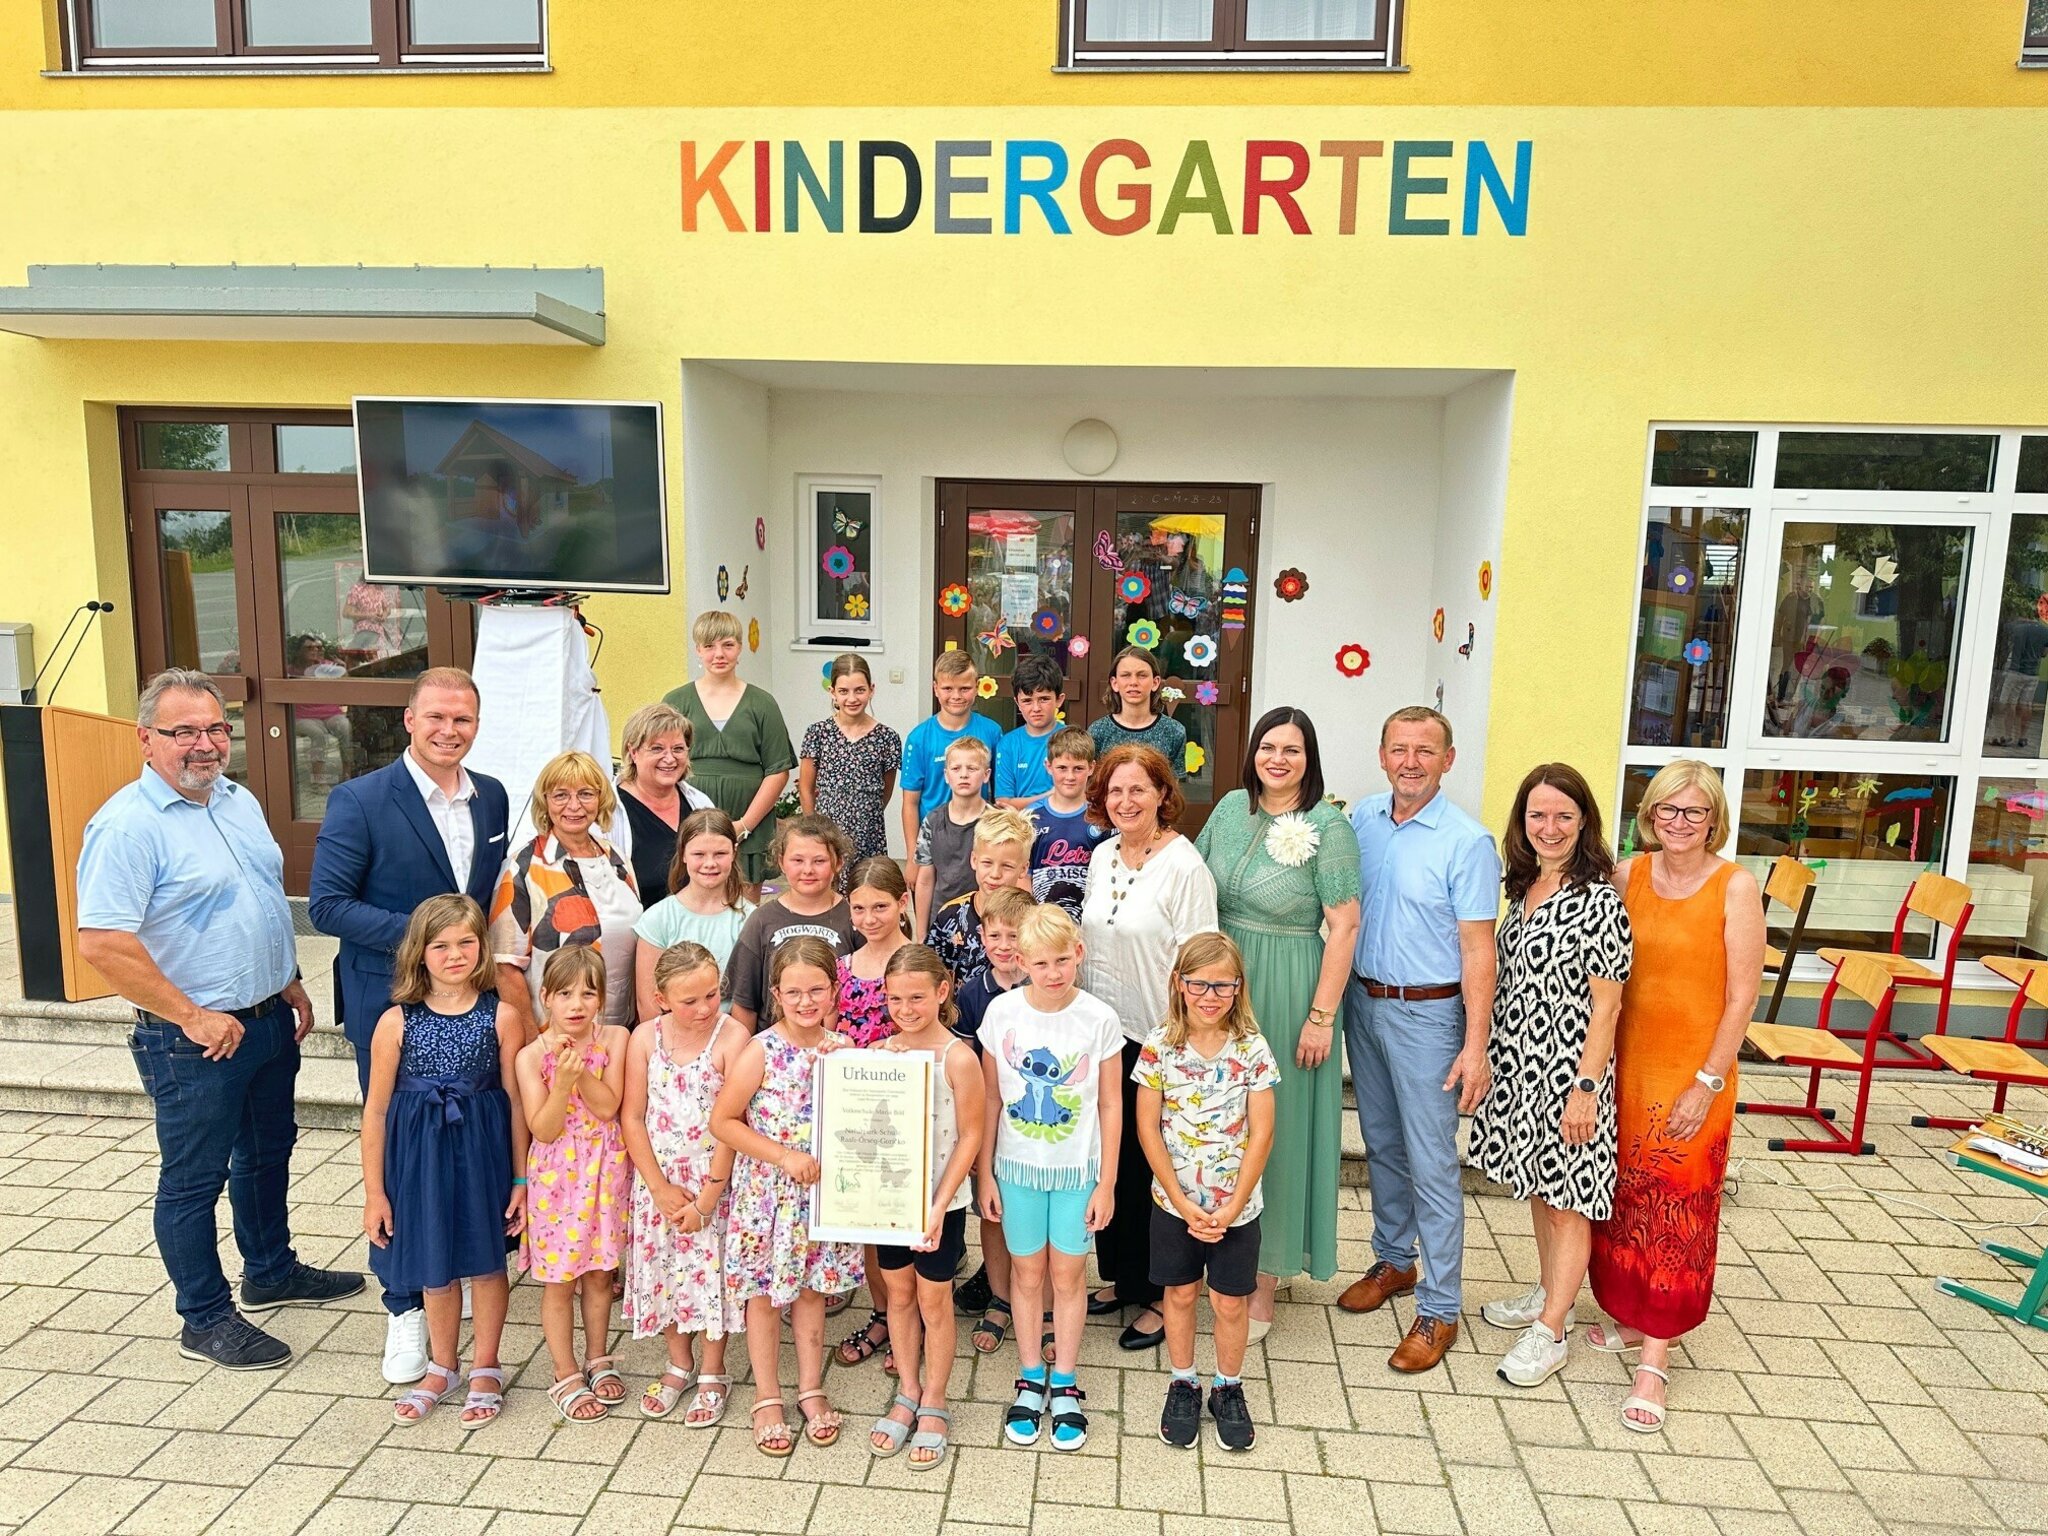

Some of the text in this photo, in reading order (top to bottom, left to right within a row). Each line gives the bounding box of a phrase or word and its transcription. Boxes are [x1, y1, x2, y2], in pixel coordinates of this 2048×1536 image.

[680, 139, 1533, 237] KINDERGARTEN
[1060, 868, 1088, 879] MSC
[779, 926, 835, 938] HOGWARTS
[843, 1066, 906, 1082] Urkunde
